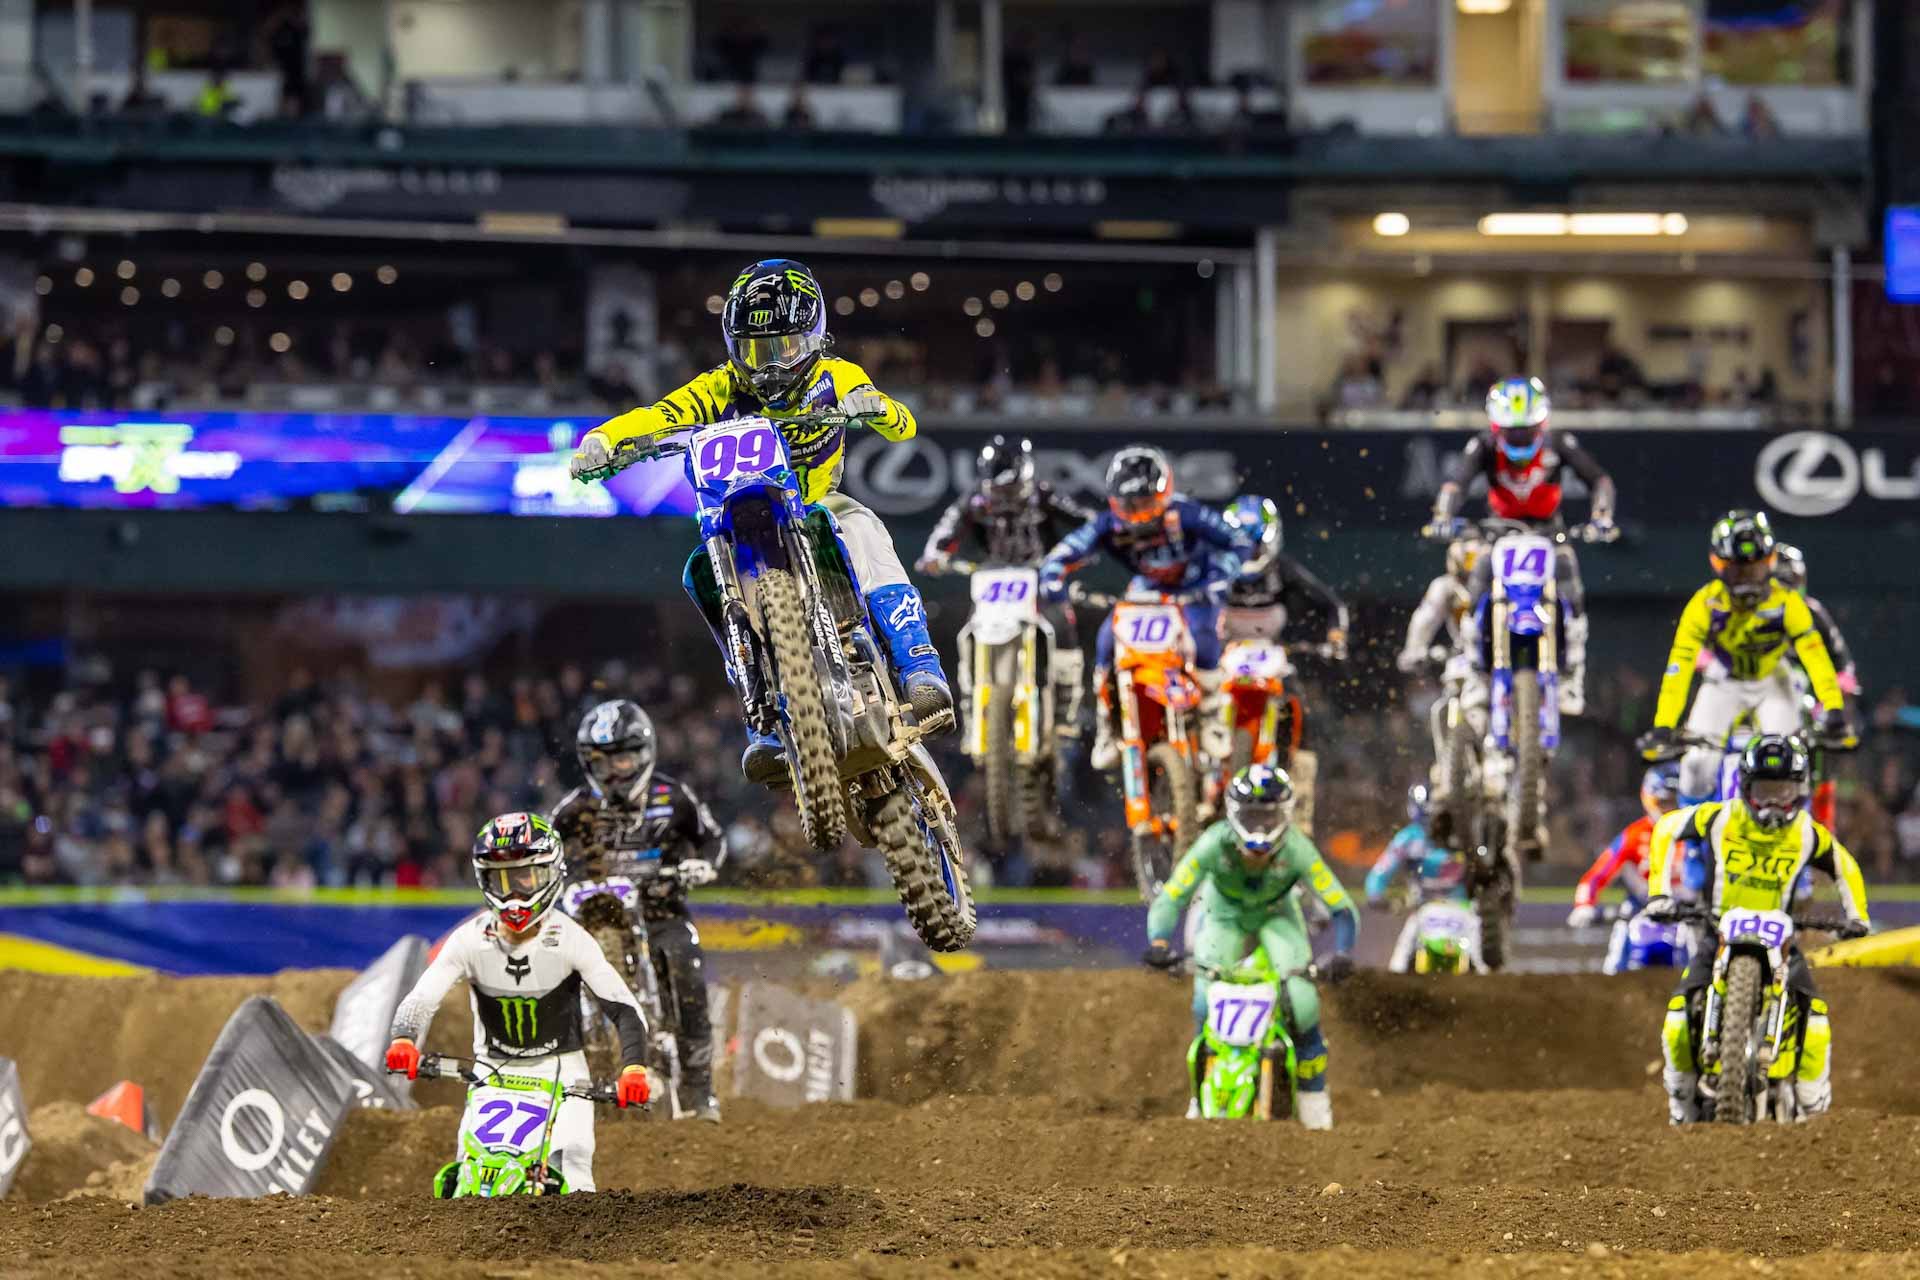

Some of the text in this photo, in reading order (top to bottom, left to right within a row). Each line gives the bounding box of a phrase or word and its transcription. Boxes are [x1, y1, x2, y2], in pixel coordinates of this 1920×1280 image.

[701, 429, 777, 481] 99
[1502, 548, 1547, 577] 14
[980, 581, 1029, 602] 49
[818, 602, 845, 668] DUNLOP
[1725, 849, 1795, 876] FXR
[1213, 998, 1272, 1039] 177
[492, 1077, 542, 1089] NTHAL
[474, 1100, 549, 1146] 27
[268, 1108, 332, 1195] KLEY
